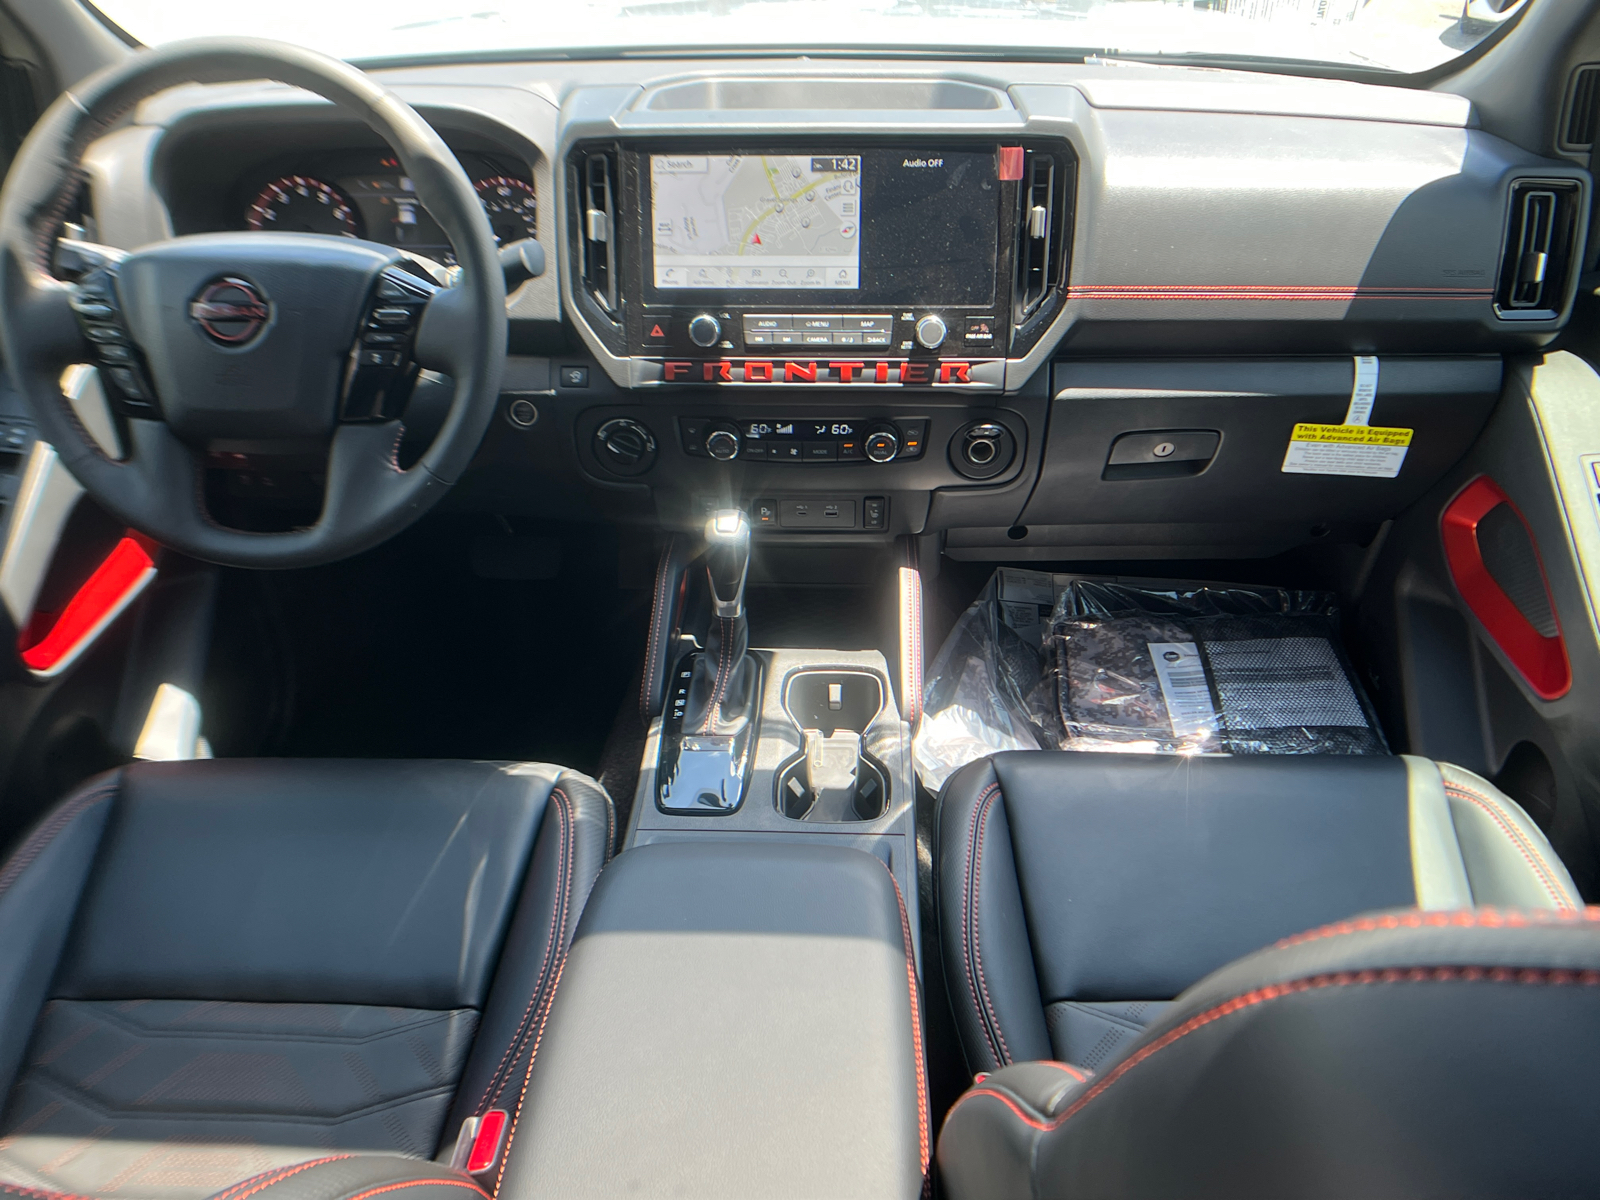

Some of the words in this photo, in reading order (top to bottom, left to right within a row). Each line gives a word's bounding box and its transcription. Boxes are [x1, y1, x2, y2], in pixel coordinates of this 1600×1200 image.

[831, 158, 857, 170] 1:42
[902, 158, 927, 168] Audio
[927, 158, 944, 168] OFF
[758, 320, 778, 328] AUDIO
[664, 361, 971, 383] FRONTIER
[1321, 427, 1354, 435] Vehicle
[1367, 429, 1410, 438] Equipped
[1320, 434, 1365, 443] Advanced
[1383, 437, 1406, 446] Bags
